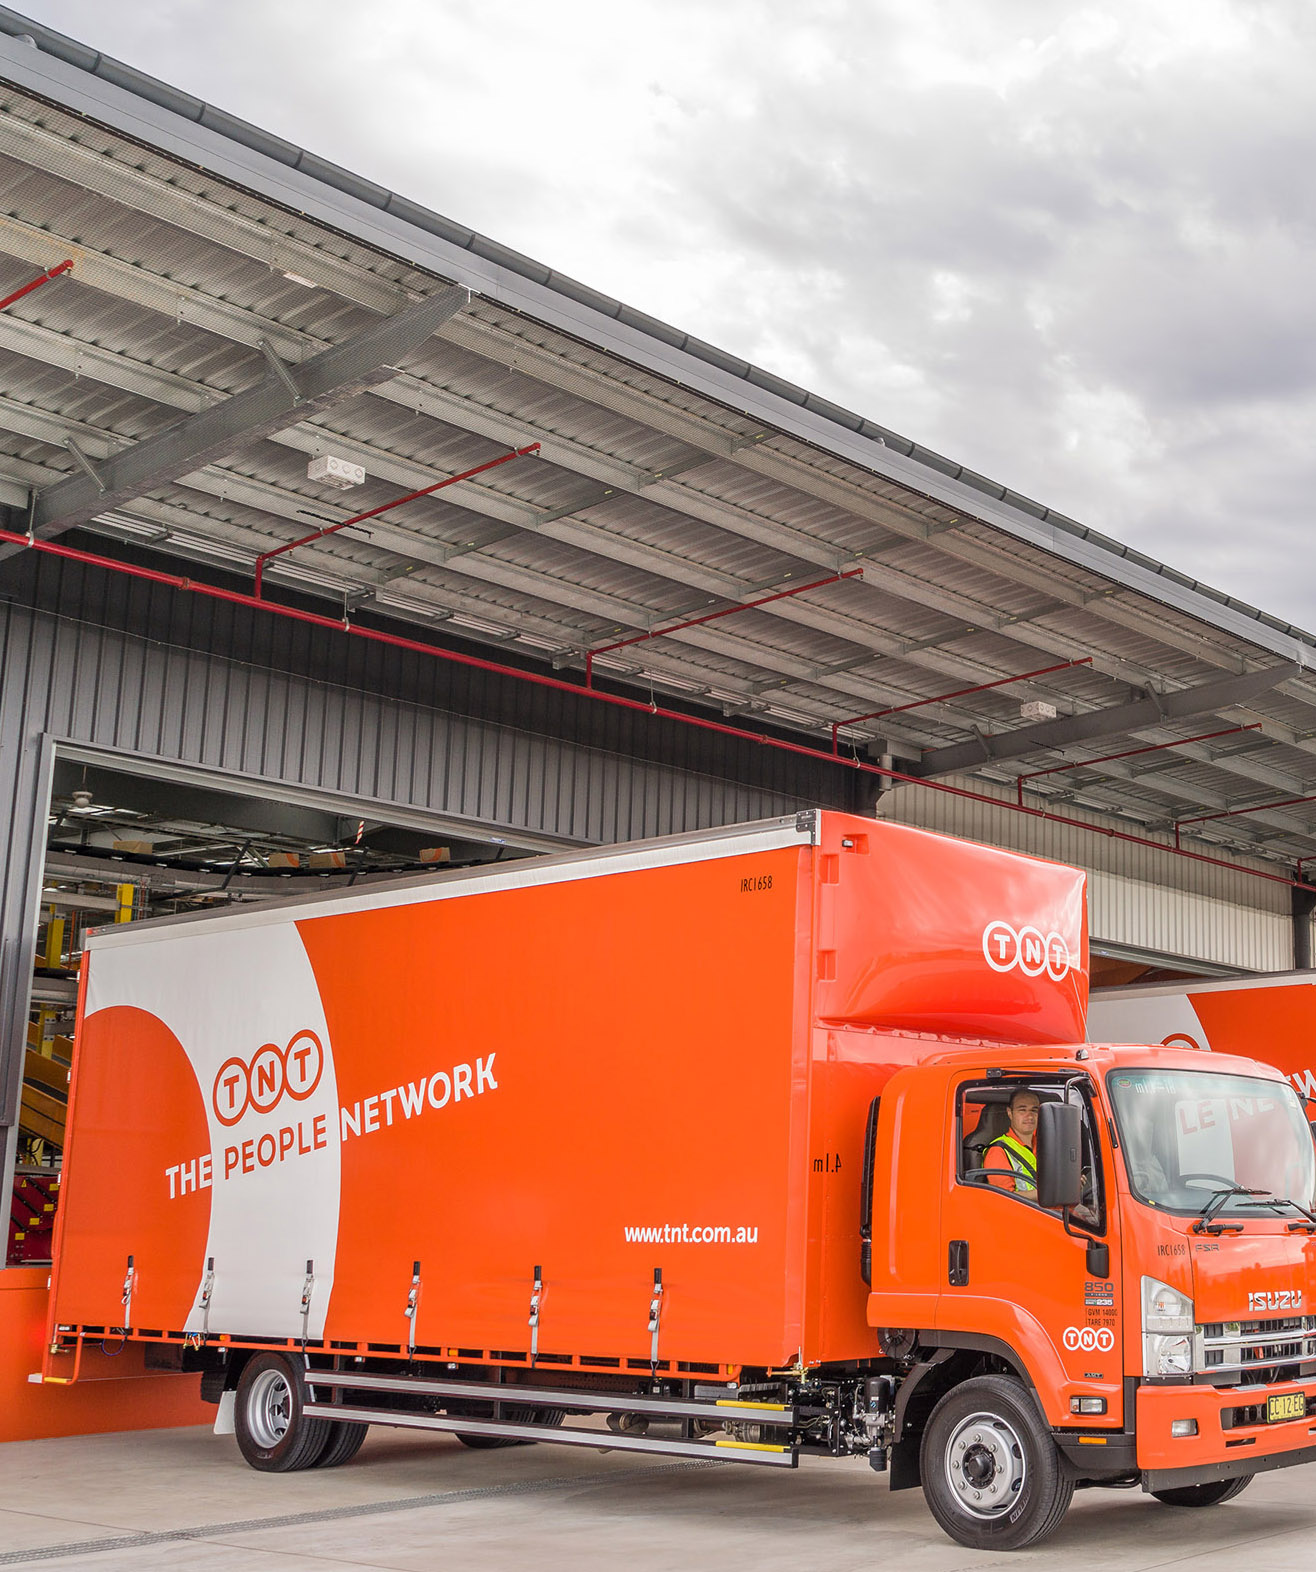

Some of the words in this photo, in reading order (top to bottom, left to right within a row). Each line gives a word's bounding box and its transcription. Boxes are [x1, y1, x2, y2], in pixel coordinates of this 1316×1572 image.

[991, 931, 1066, 971] TNT
[221, 1044, 314, 1112] TNT
[165, 1153, 213, 1199] THE
[224, 1113, 328, 1181] PEOPLE
[340, 1052, 499, 1142] NETWORK
[624, 1223, 759, 1243] www.tnt.com.au
[1084, 1282, 1114, 1292] 850
[1248, 1289, 1302, 1312] ISUZU
[1066, 1331, 1110, 1347] TNT
